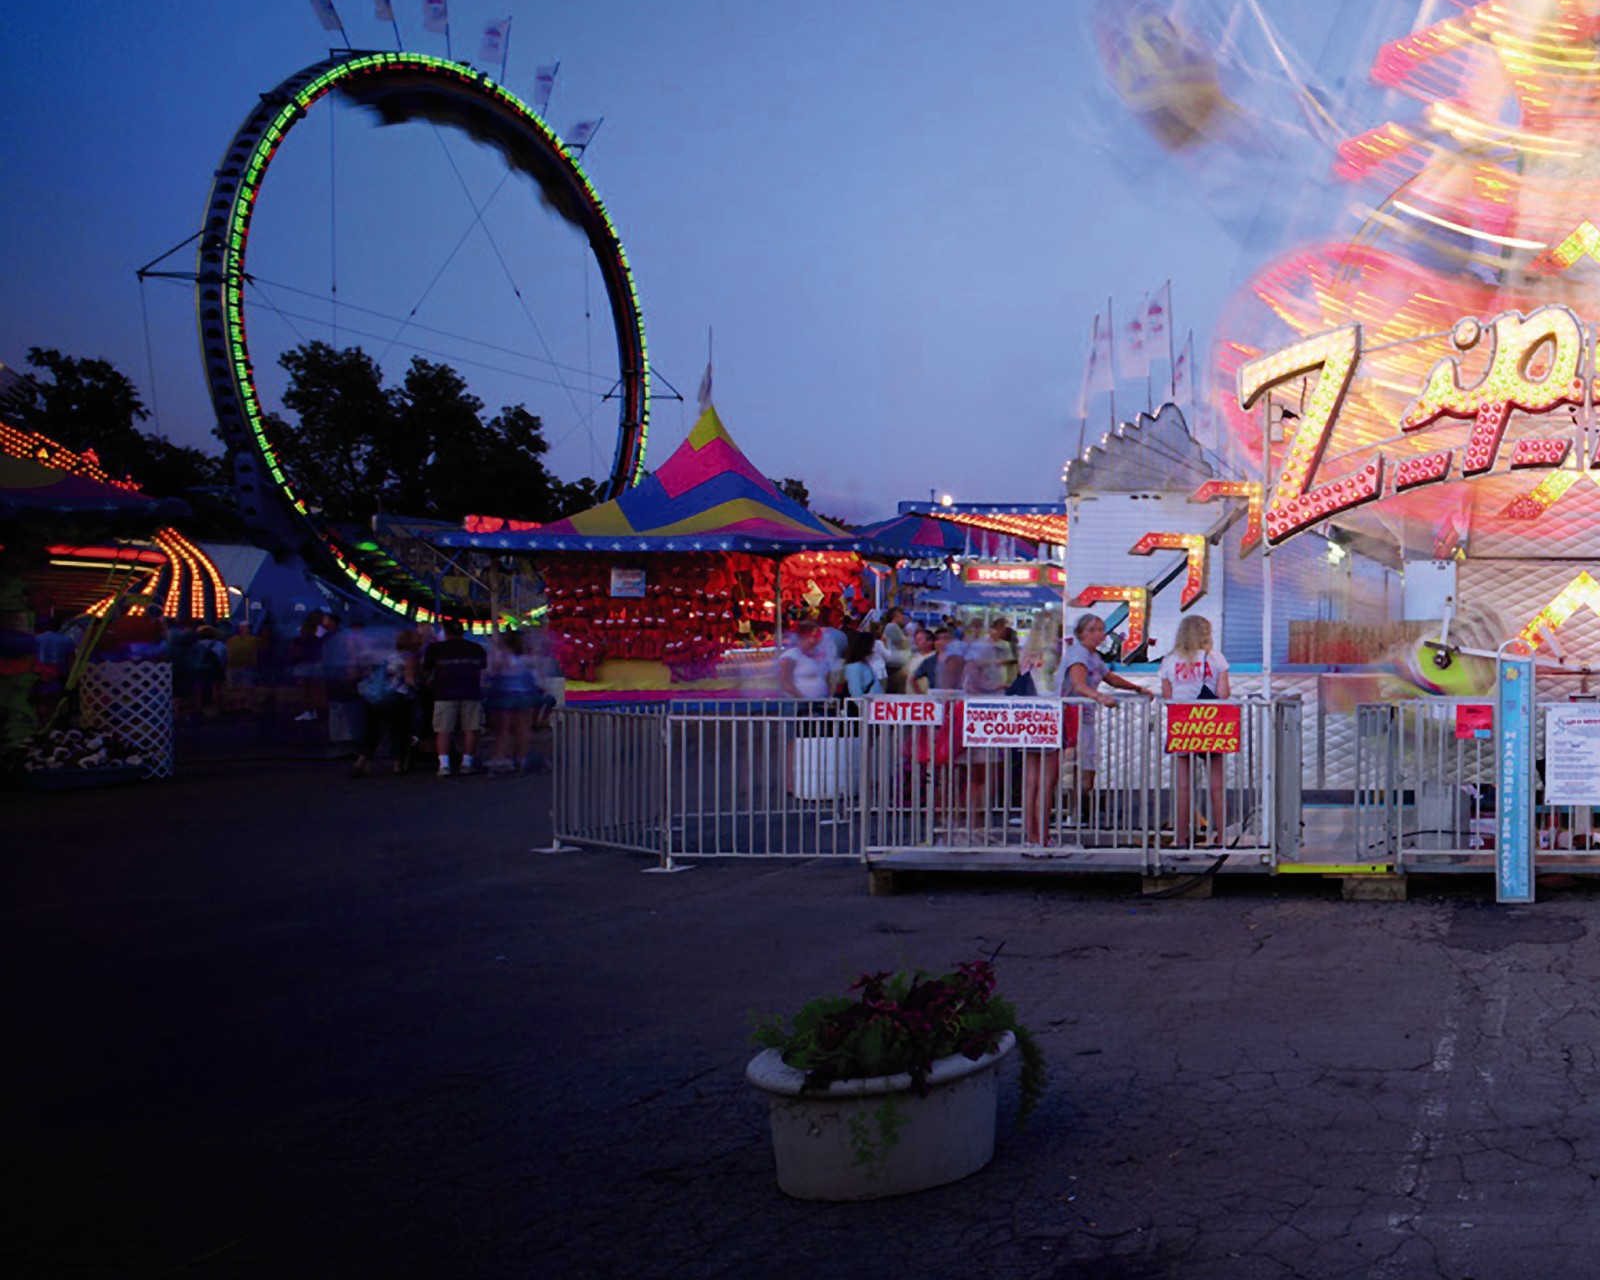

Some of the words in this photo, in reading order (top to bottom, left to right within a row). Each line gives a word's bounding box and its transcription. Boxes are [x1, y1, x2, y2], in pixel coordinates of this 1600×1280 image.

[874, 702, 936, 721] ENTER
[966, 710, 1009, 723] TODAY'S
[1188, 706, 1218, 720] NO
[966, 722, 976, 734] 4
[983, 722, 1059, 735] COUPONS
[1170, 721, 1236, 735] SINGLE
[1168, 737, 1238, 751] RIDERS
